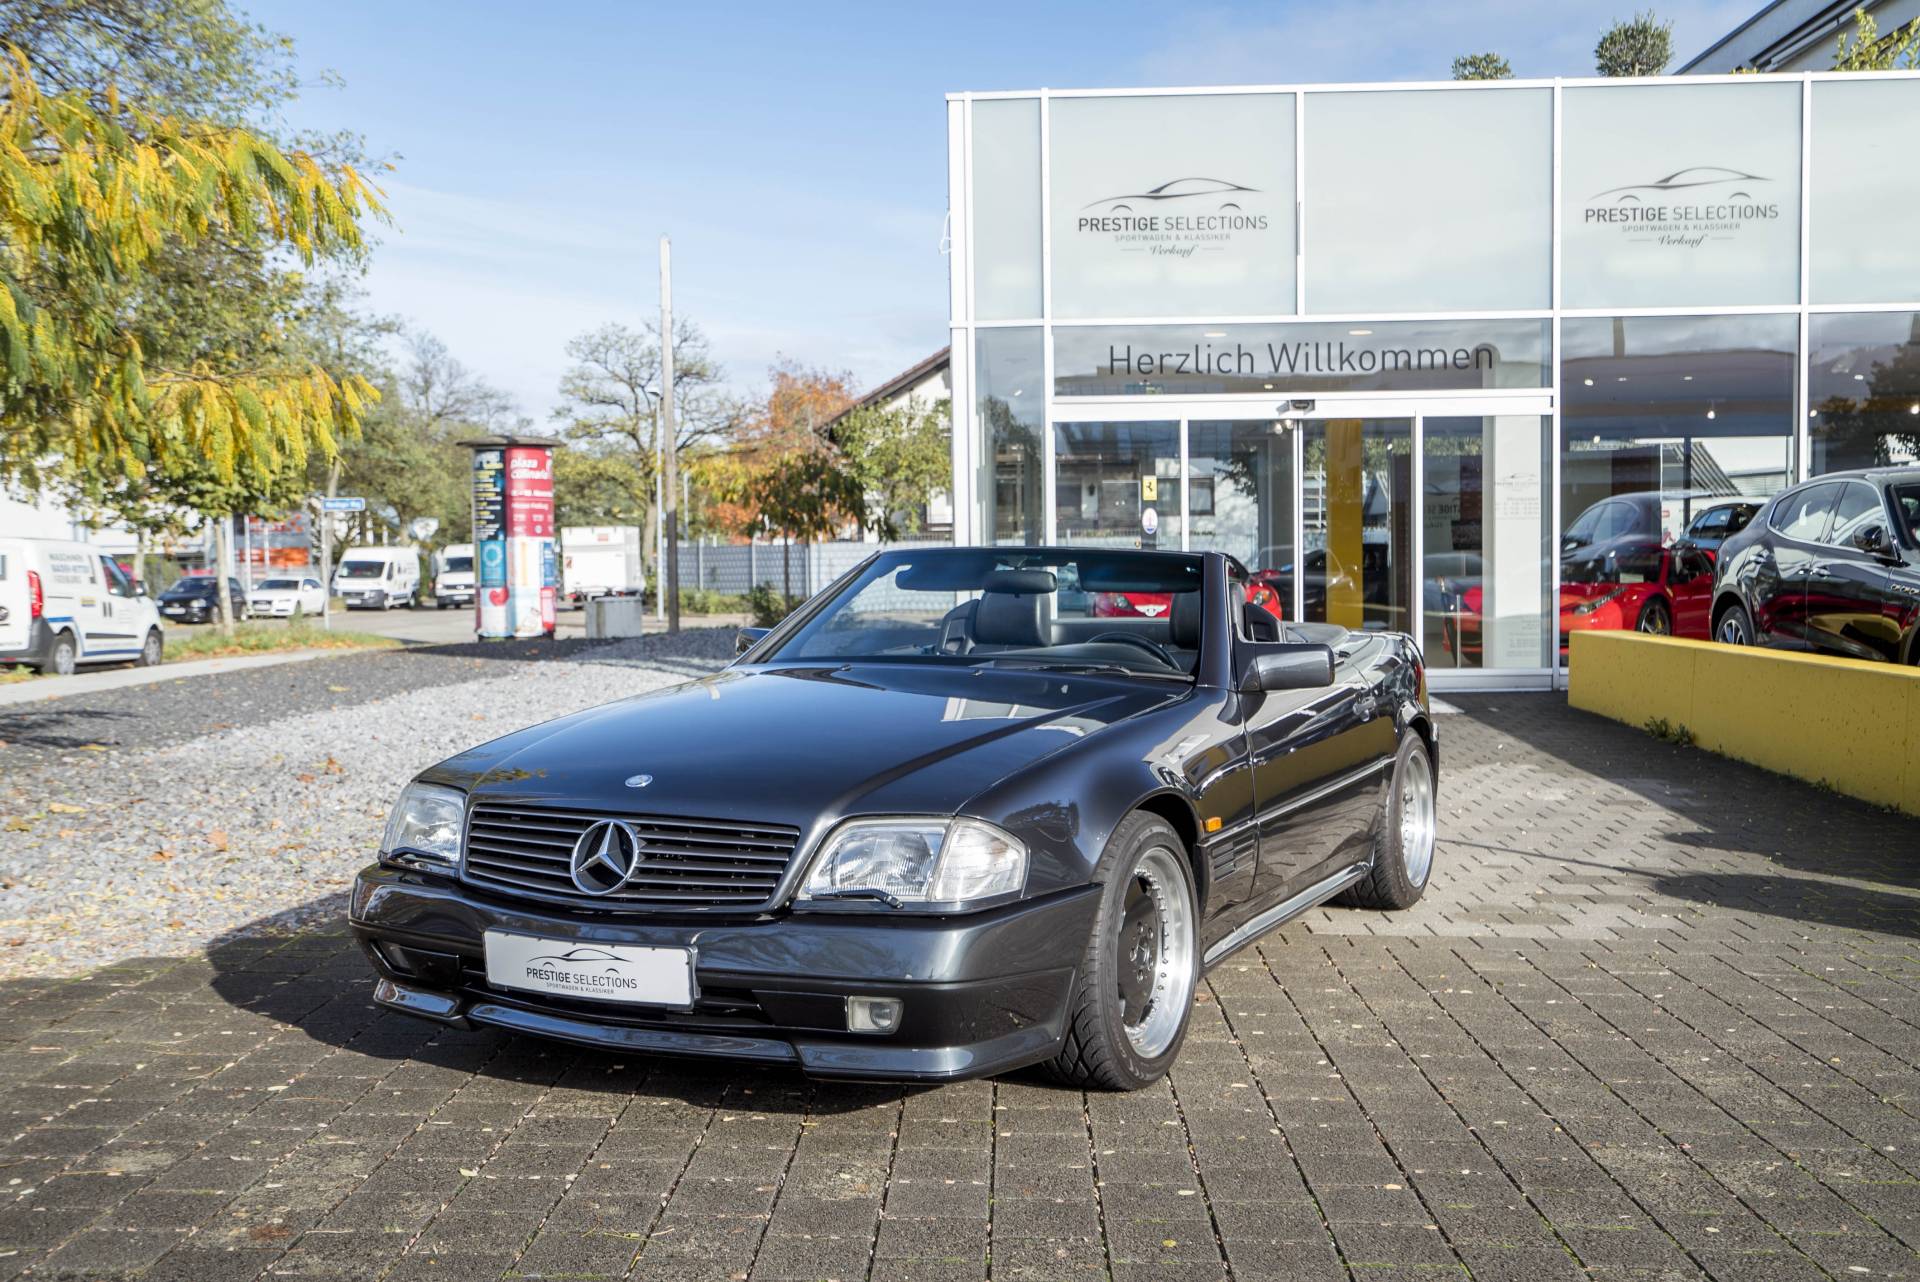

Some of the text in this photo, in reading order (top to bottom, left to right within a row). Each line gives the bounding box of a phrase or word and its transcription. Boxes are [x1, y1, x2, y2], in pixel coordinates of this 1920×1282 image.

[1584, 204, 1779, 223] PRESTIGE SELECTIONS
[1078, 215, 1268, 232] PRESTIGE SELECTIONS
[1622, 223, 1681, 232] SPORTWAGEN
[1693, 222, 1741, 230] KLASSIKER
[1114, 233, 1231, 243] SPORTWAGEN & KLASSIKER
[1657, 233, 1709, 248] Verkauf
[1149, 244, 1199, 258] Verkauf
[1108, 341, 1493, 376] Herzlich Willkommen
[526, 967, 638, 989] PRESTIGE SELECTIONS
[547, 982, 579, 991] SPORTWAGEN
[585, 986, 615, 994] KLASSIKER
